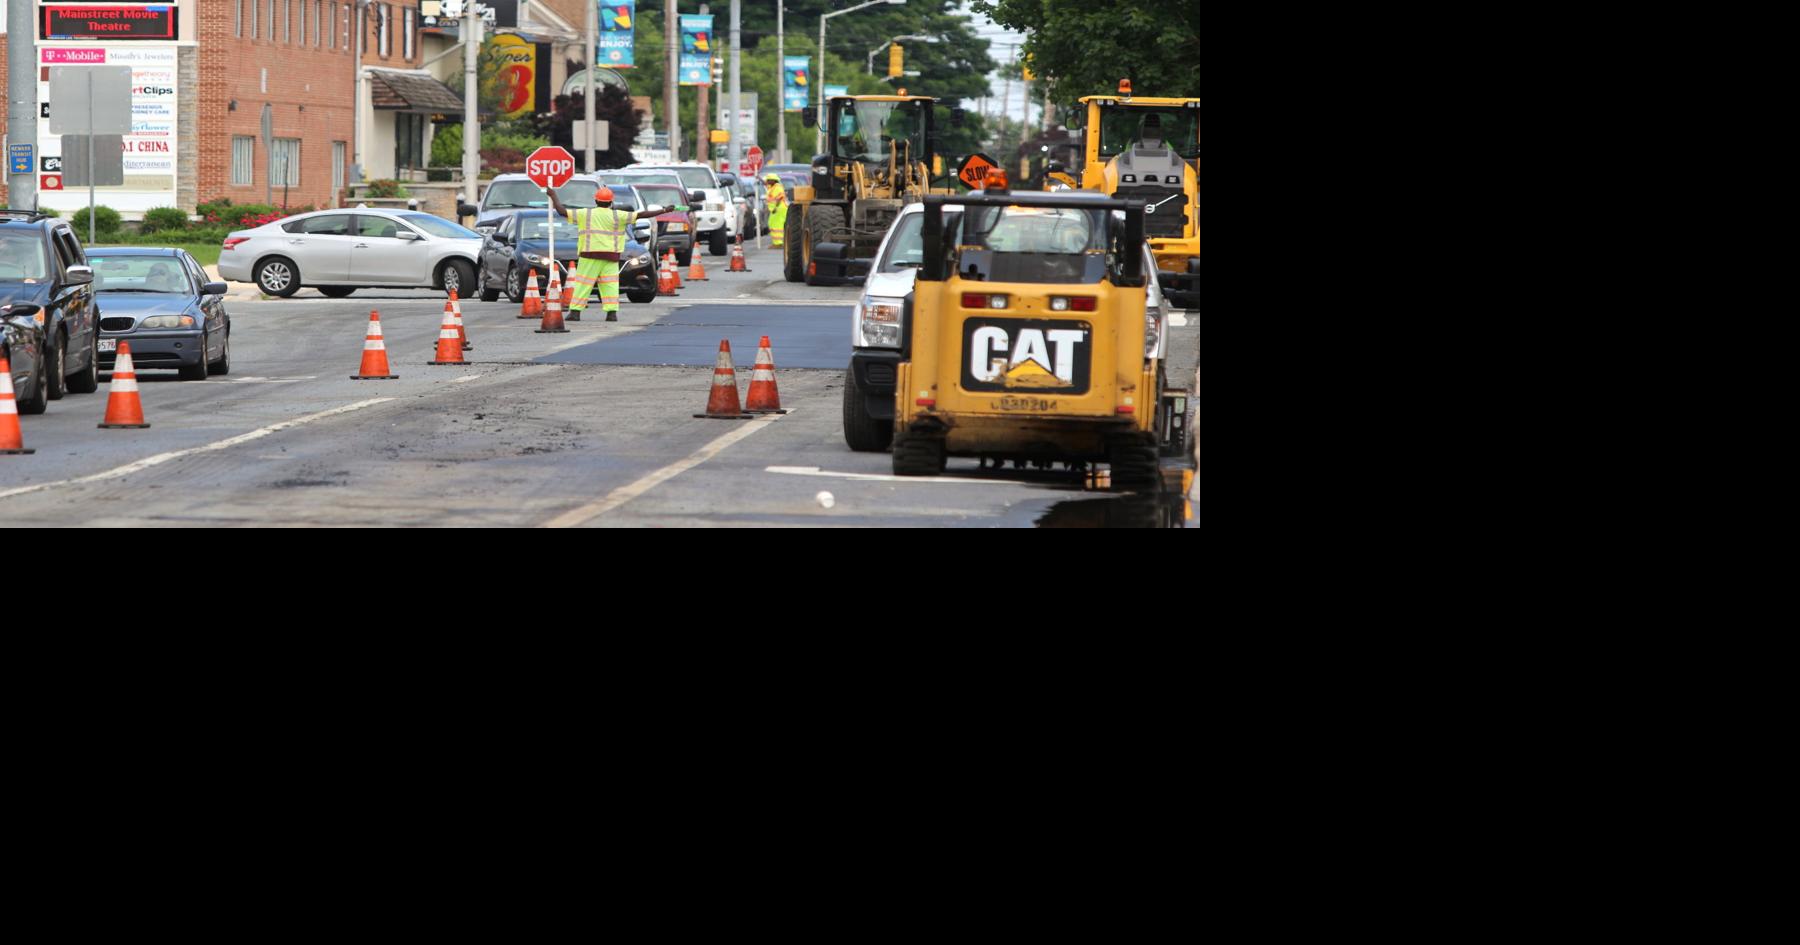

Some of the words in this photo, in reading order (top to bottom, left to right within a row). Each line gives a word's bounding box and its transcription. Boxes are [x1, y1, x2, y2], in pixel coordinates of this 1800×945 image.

[59, 9, 120, 19] Mainstreet
[123, 9, 159, 19] Movie
[88, 21, 131, 31] Theatre
[600, 40, 633, 48] ENJOY.
[132, 86, 173, 95] rtClips
[138, 141, 169, 152] CHINA
[749, 154, 762, 162] STOP
[530, 159, 571, 175] STOP
[971, 326, 1084, 385] CAT
